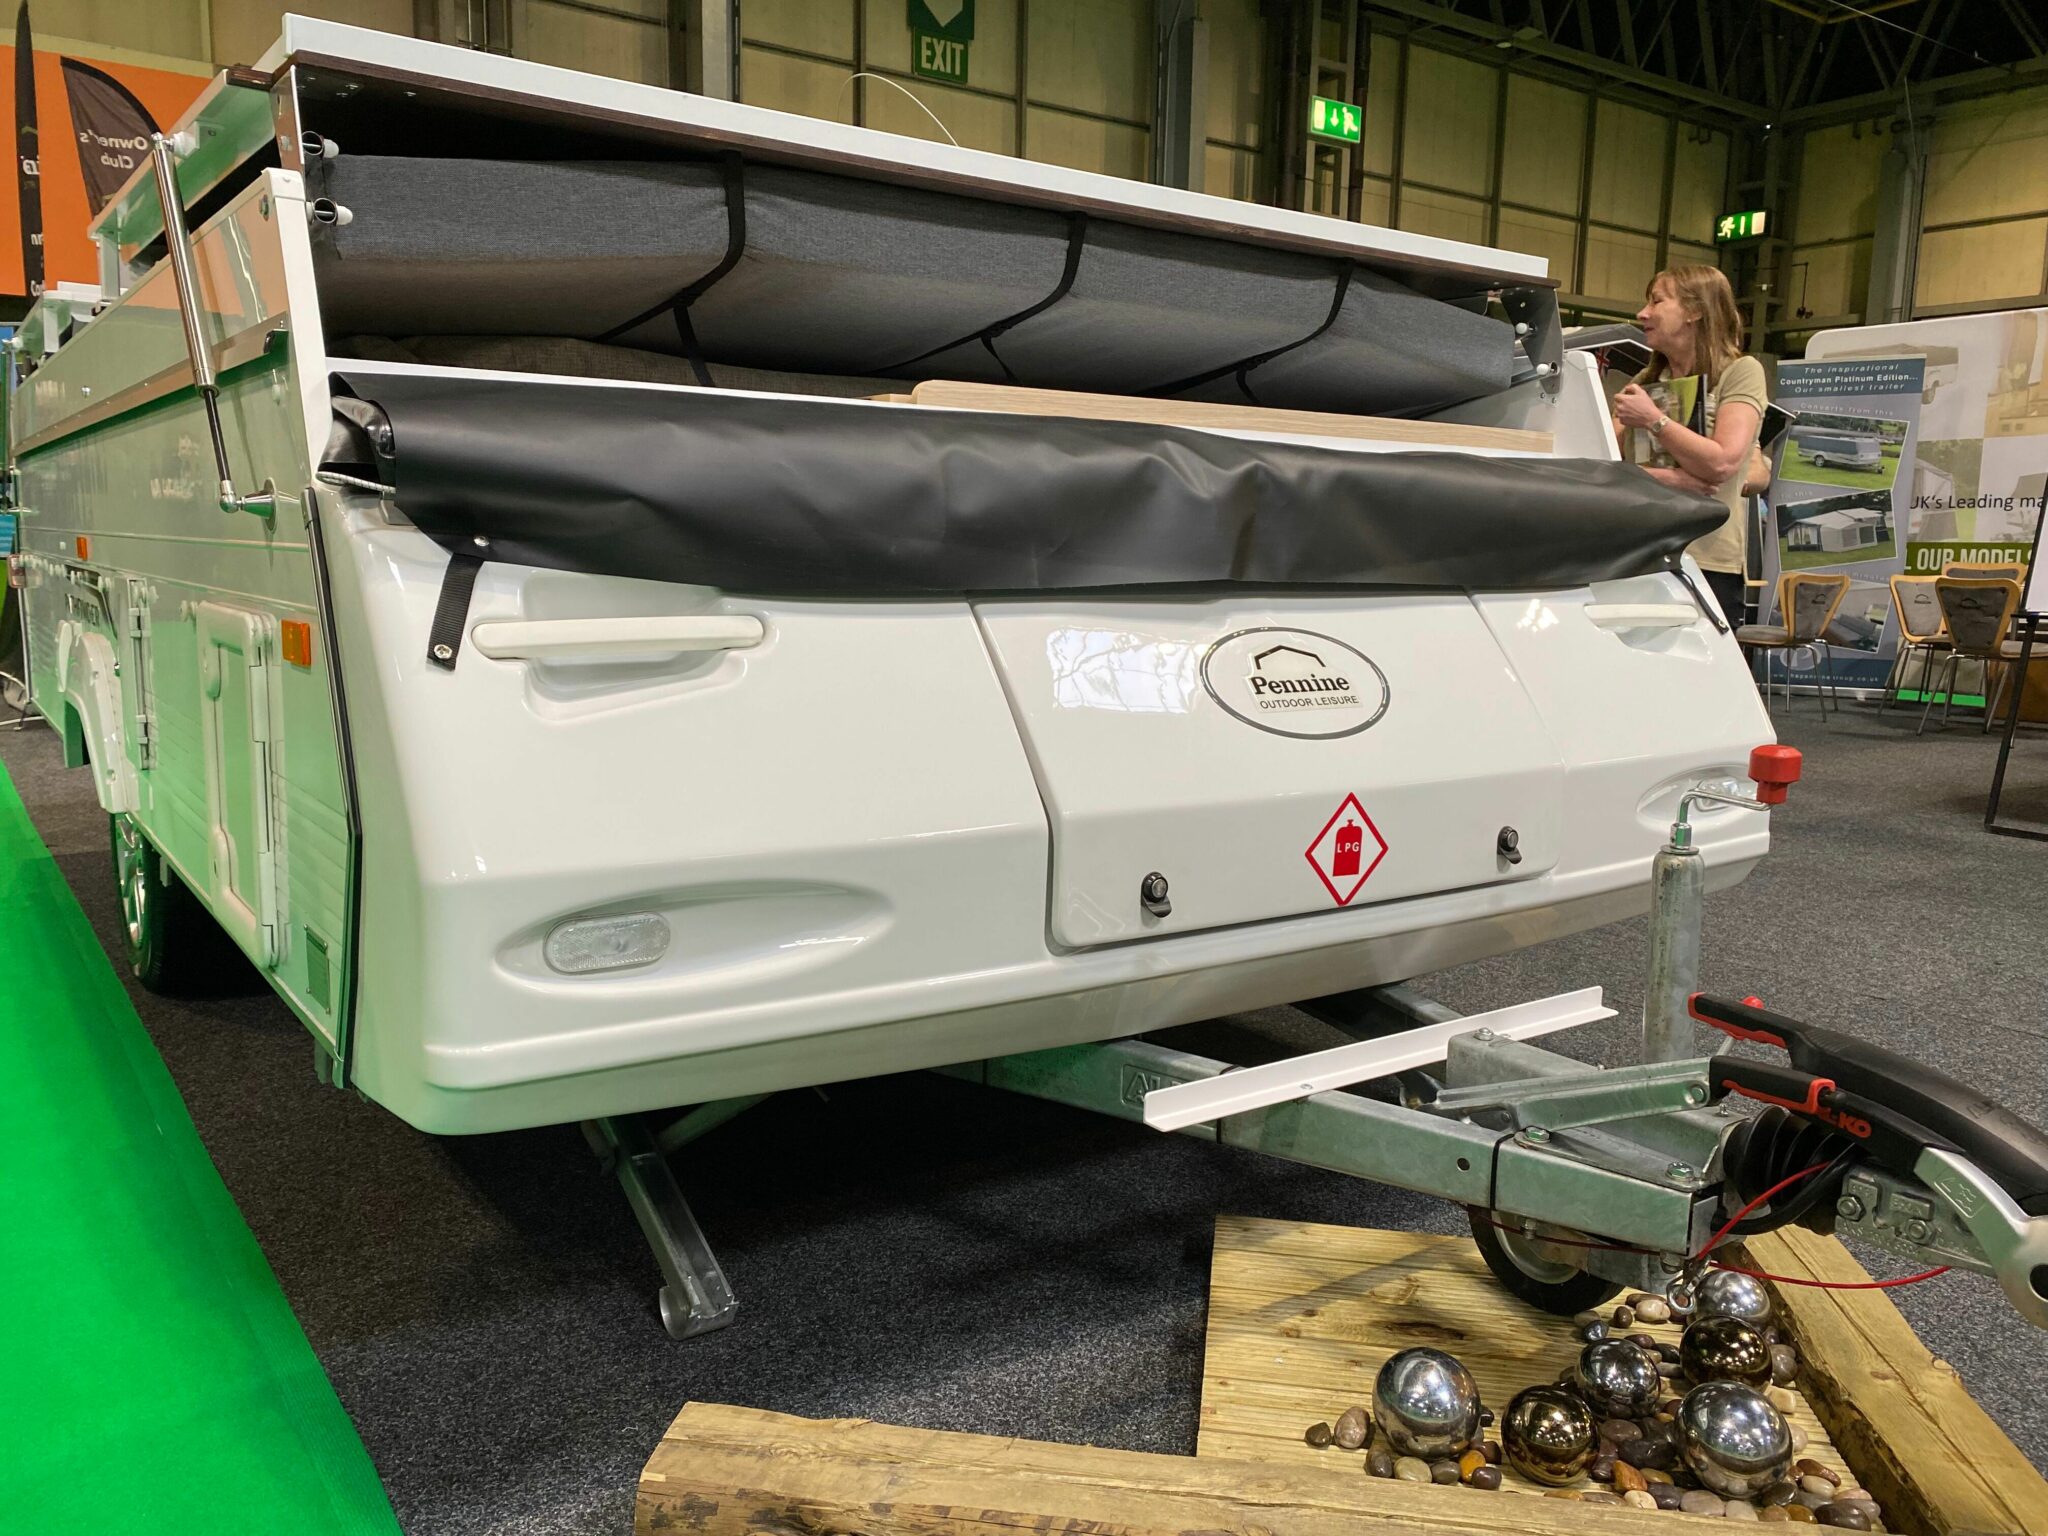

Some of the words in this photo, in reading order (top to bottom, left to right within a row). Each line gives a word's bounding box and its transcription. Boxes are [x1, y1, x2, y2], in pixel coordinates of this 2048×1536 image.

[921, 35, 964, 76] EXIT
[1827, 363, 1899, 374] inspirational
[1780, 377, 1832, 386] Countryman
[1835, 375, 1874, 383] Platinum
[1818, 384, 1864, 392] smallest
[1869, 383, 1905, 391] trailer
[1848, 406, 1870, 414] from
[1949, 494, 2014, 511] Leading
[1250, 673, 1350, 695] Pennine
[1259, 697, 1314, 709] OUTDOOR
[1314, 695, 1360, 706] LEISURE
[1337, 841, 1360, 854] LPG
